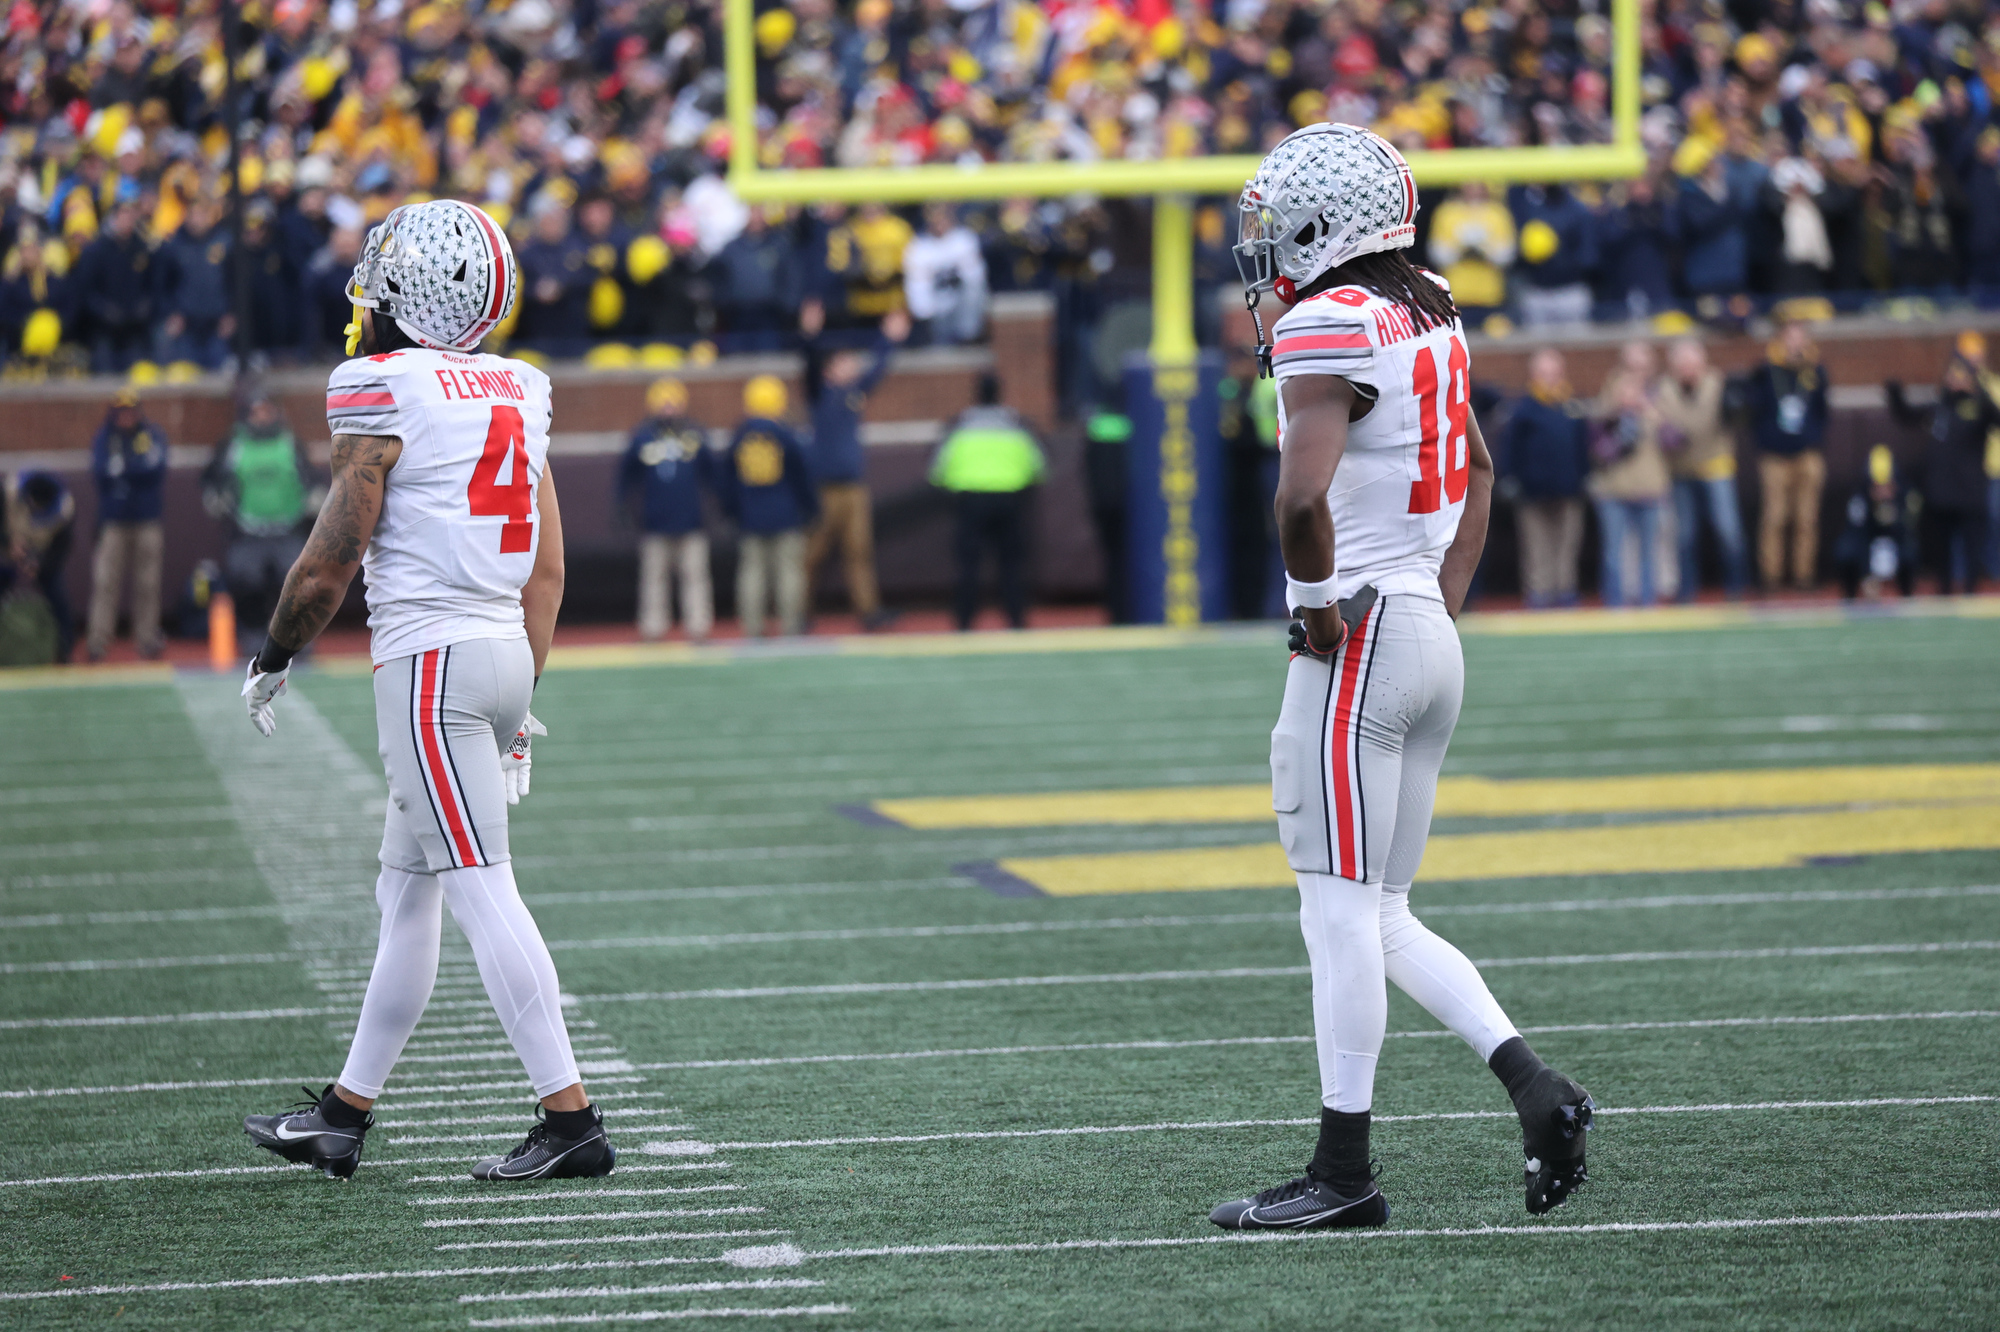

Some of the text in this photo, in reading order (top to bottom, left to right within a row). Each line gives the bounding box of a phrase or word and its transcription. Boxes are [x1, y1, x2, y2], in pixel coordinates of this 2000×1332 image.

[435, 369, 525, 401] FLEMING
[1408, 335, 1471, 514] 18
[467, 405, 533, 554] 4
